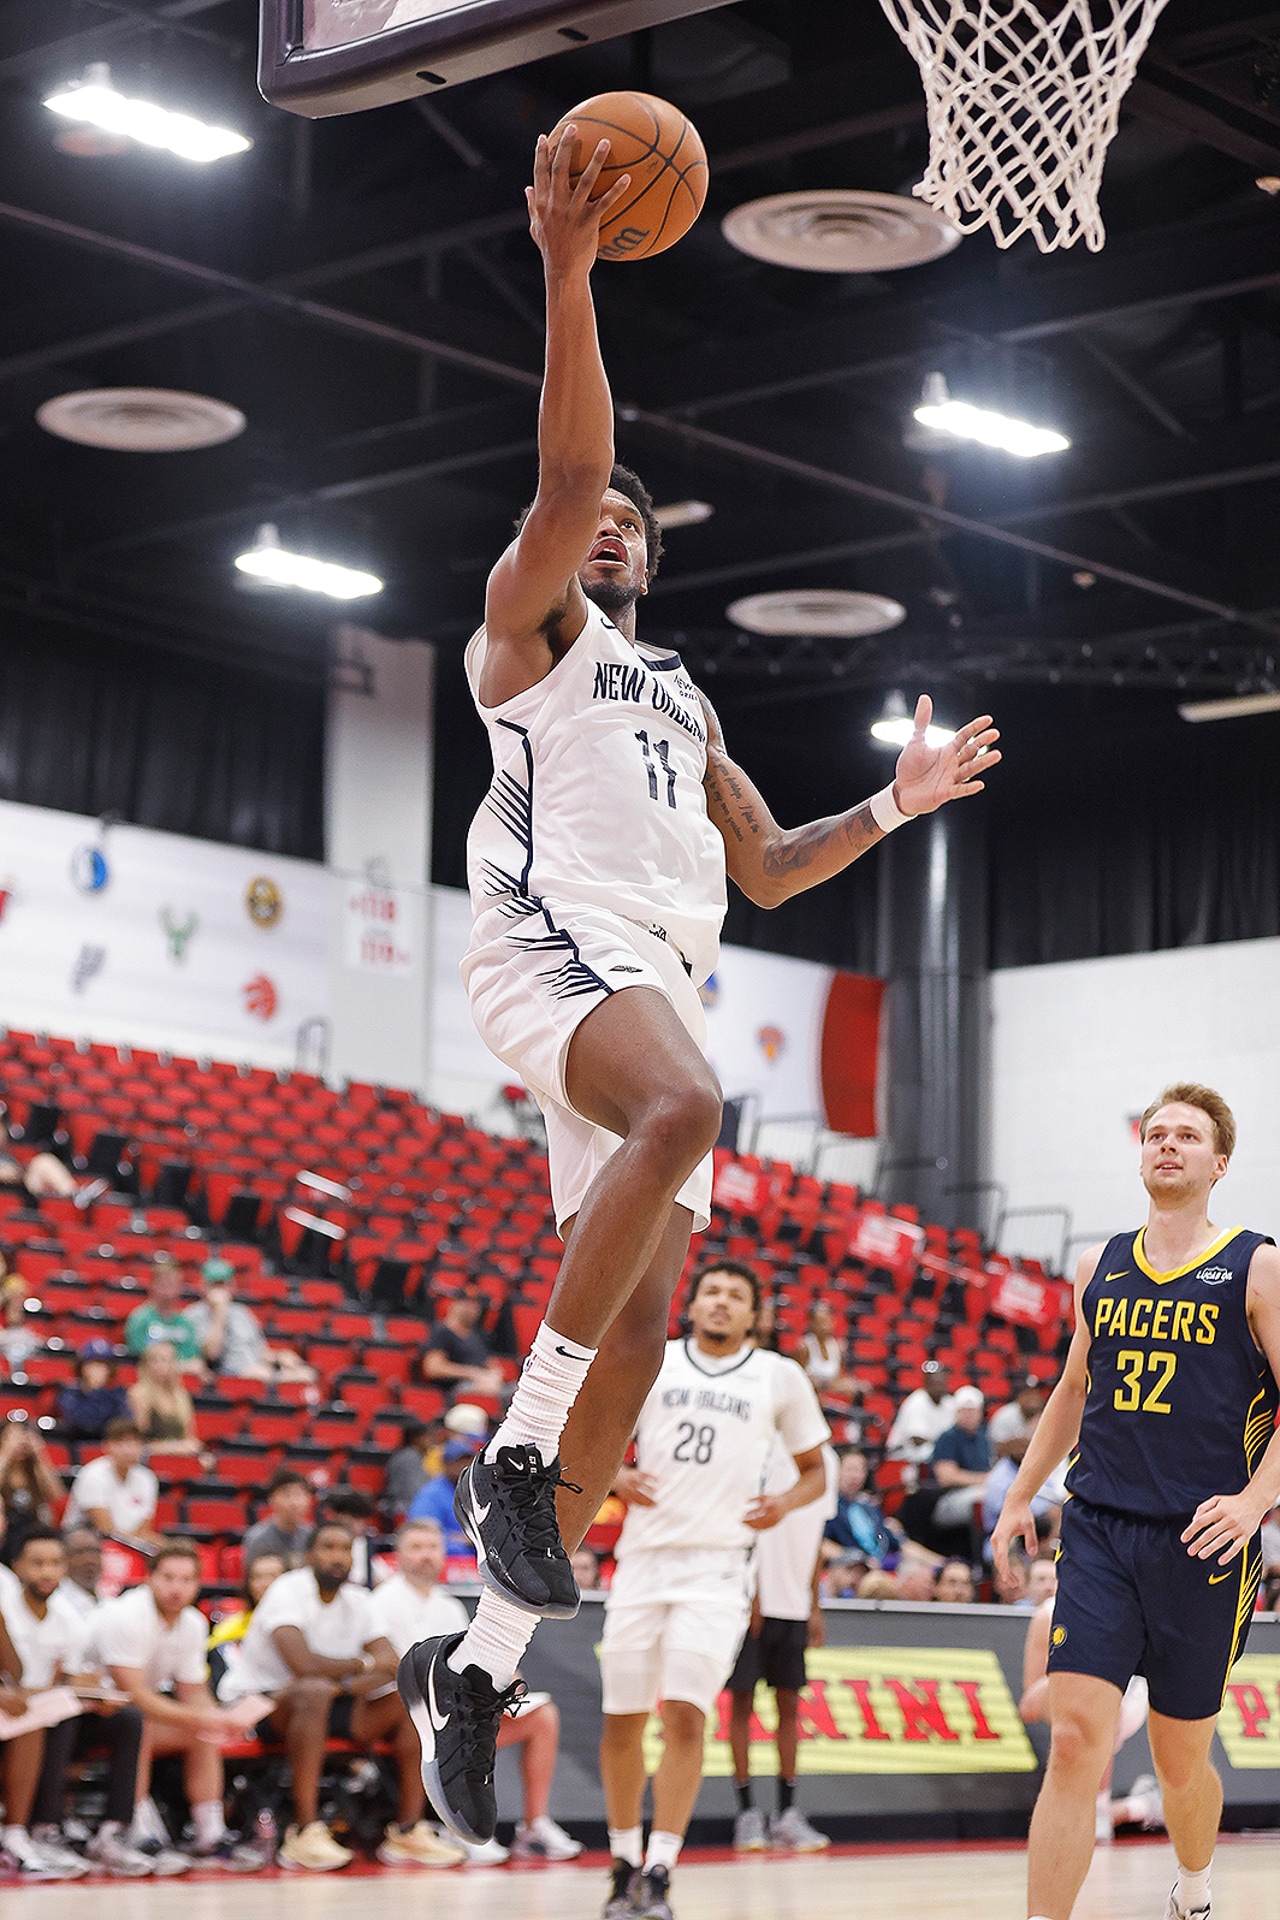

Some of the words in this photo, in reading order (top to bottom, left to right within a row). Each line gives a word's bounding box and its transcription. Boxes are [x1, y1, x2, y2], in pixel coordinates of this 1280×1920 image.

[593, 661, 646, 703] NEW
[634, 729, 677, 809] 11
[1094, 1297, 1220, 1345] PACERS
[1113, 1350, 1177, 1415] 32
[673, 1421, 715, 1465] 28
